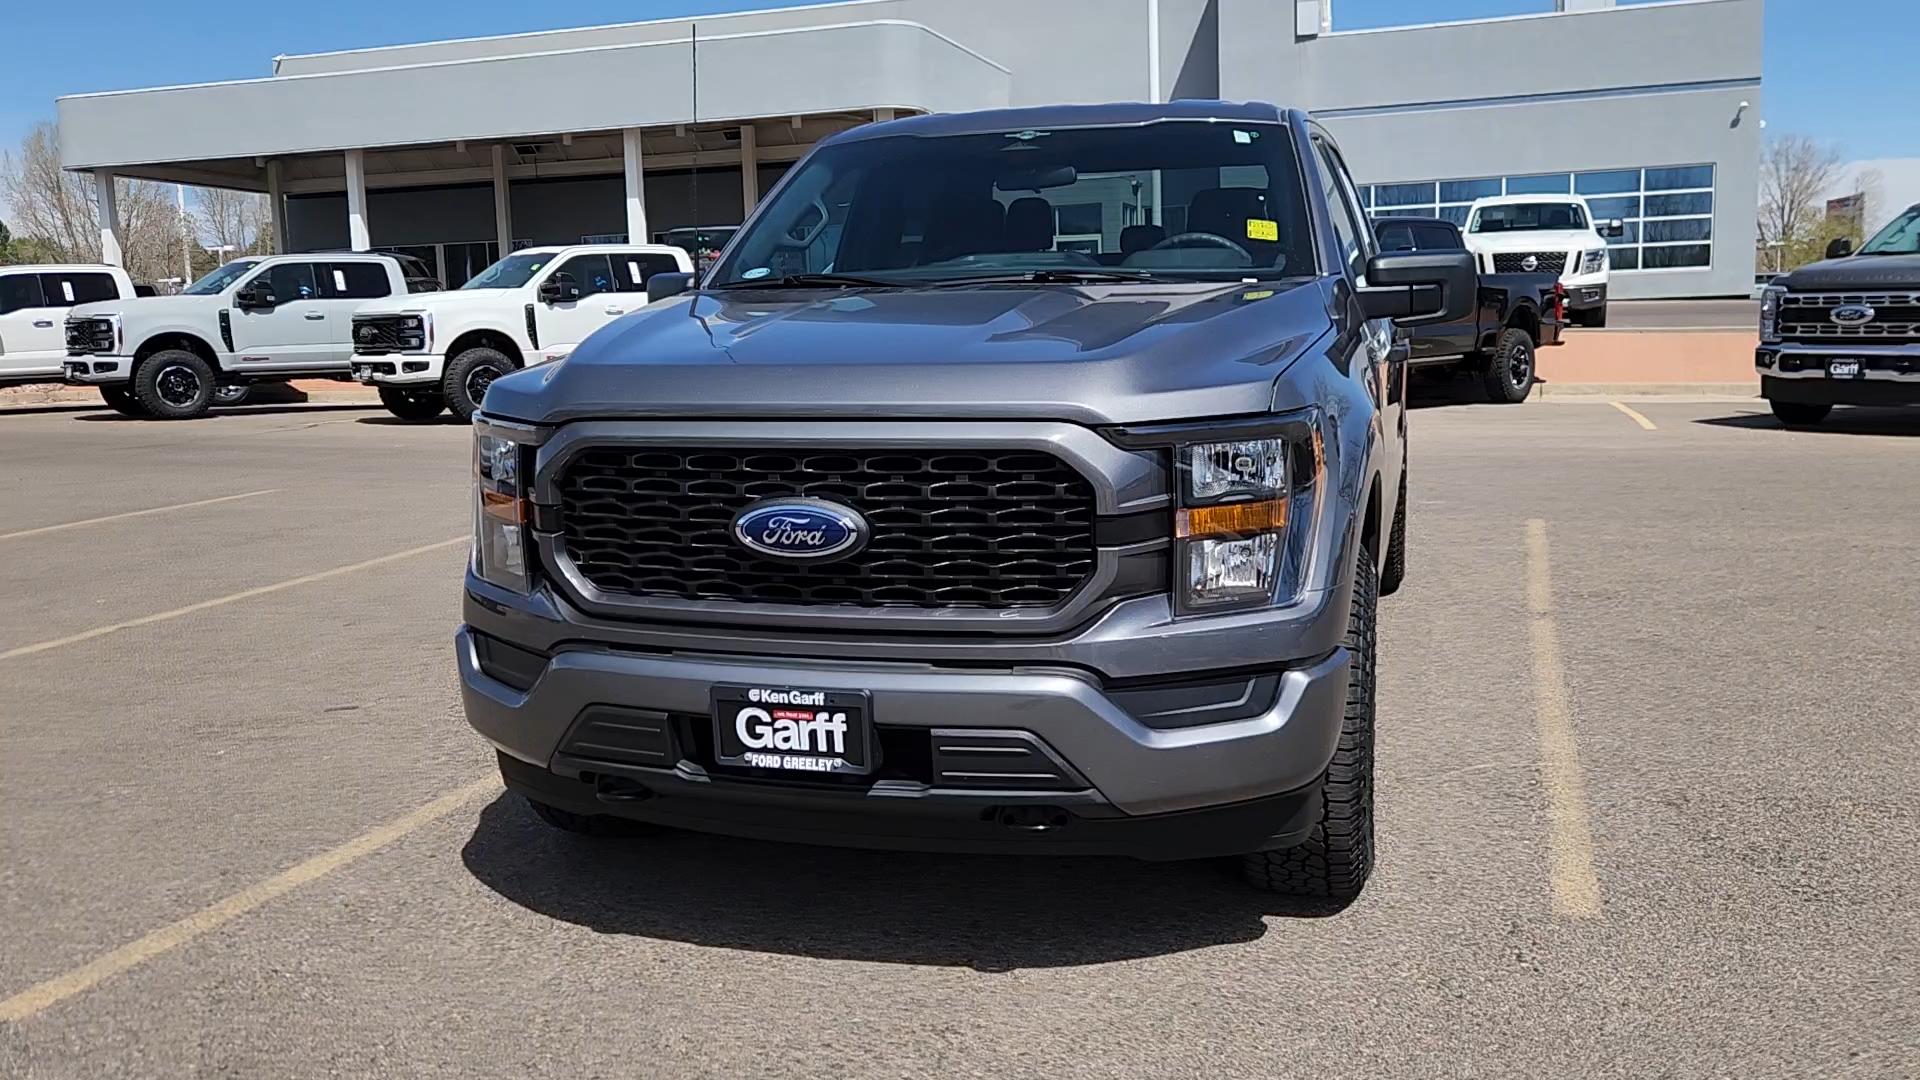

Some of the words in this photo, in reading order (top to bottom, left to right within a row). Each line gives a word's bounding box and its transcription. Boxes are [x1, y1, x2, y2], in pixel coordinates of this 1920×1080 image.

[762, 516, 827, 546] Ford
[761, 689, 788, 704] Ken
[789, 691, 825, 705] Garff
[735, 707, 848, 753] Garff
[751, 754, 781, 768] FORD
[783, 757, 833, 771] GREELEY
